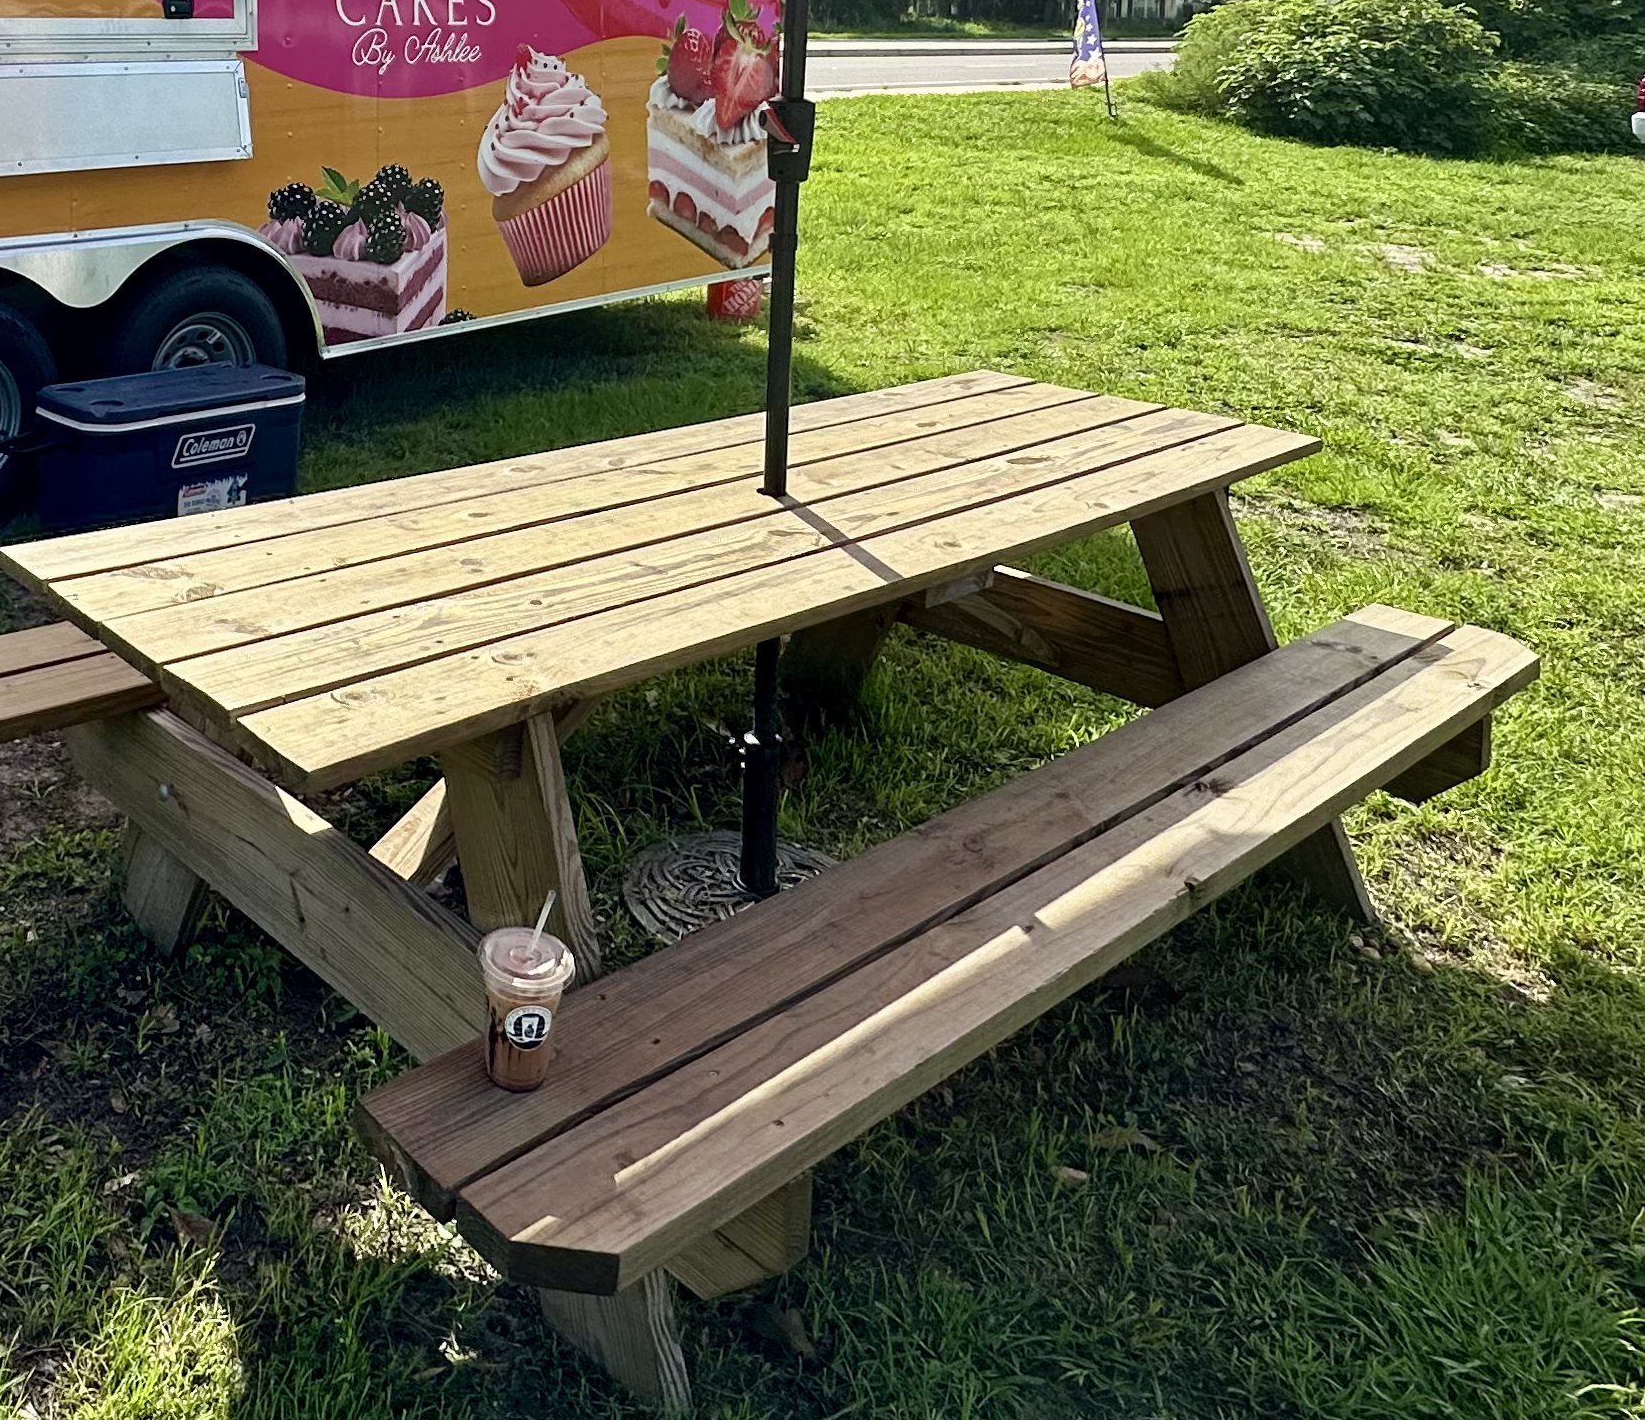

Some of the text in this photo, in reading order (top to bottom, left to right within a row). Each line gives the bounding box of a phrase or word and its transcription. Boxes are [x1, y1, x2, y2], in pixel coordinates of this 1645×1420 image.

[351, 27, 482, 75] By Ashlee
[182, 436, 235, 457] Coleman
